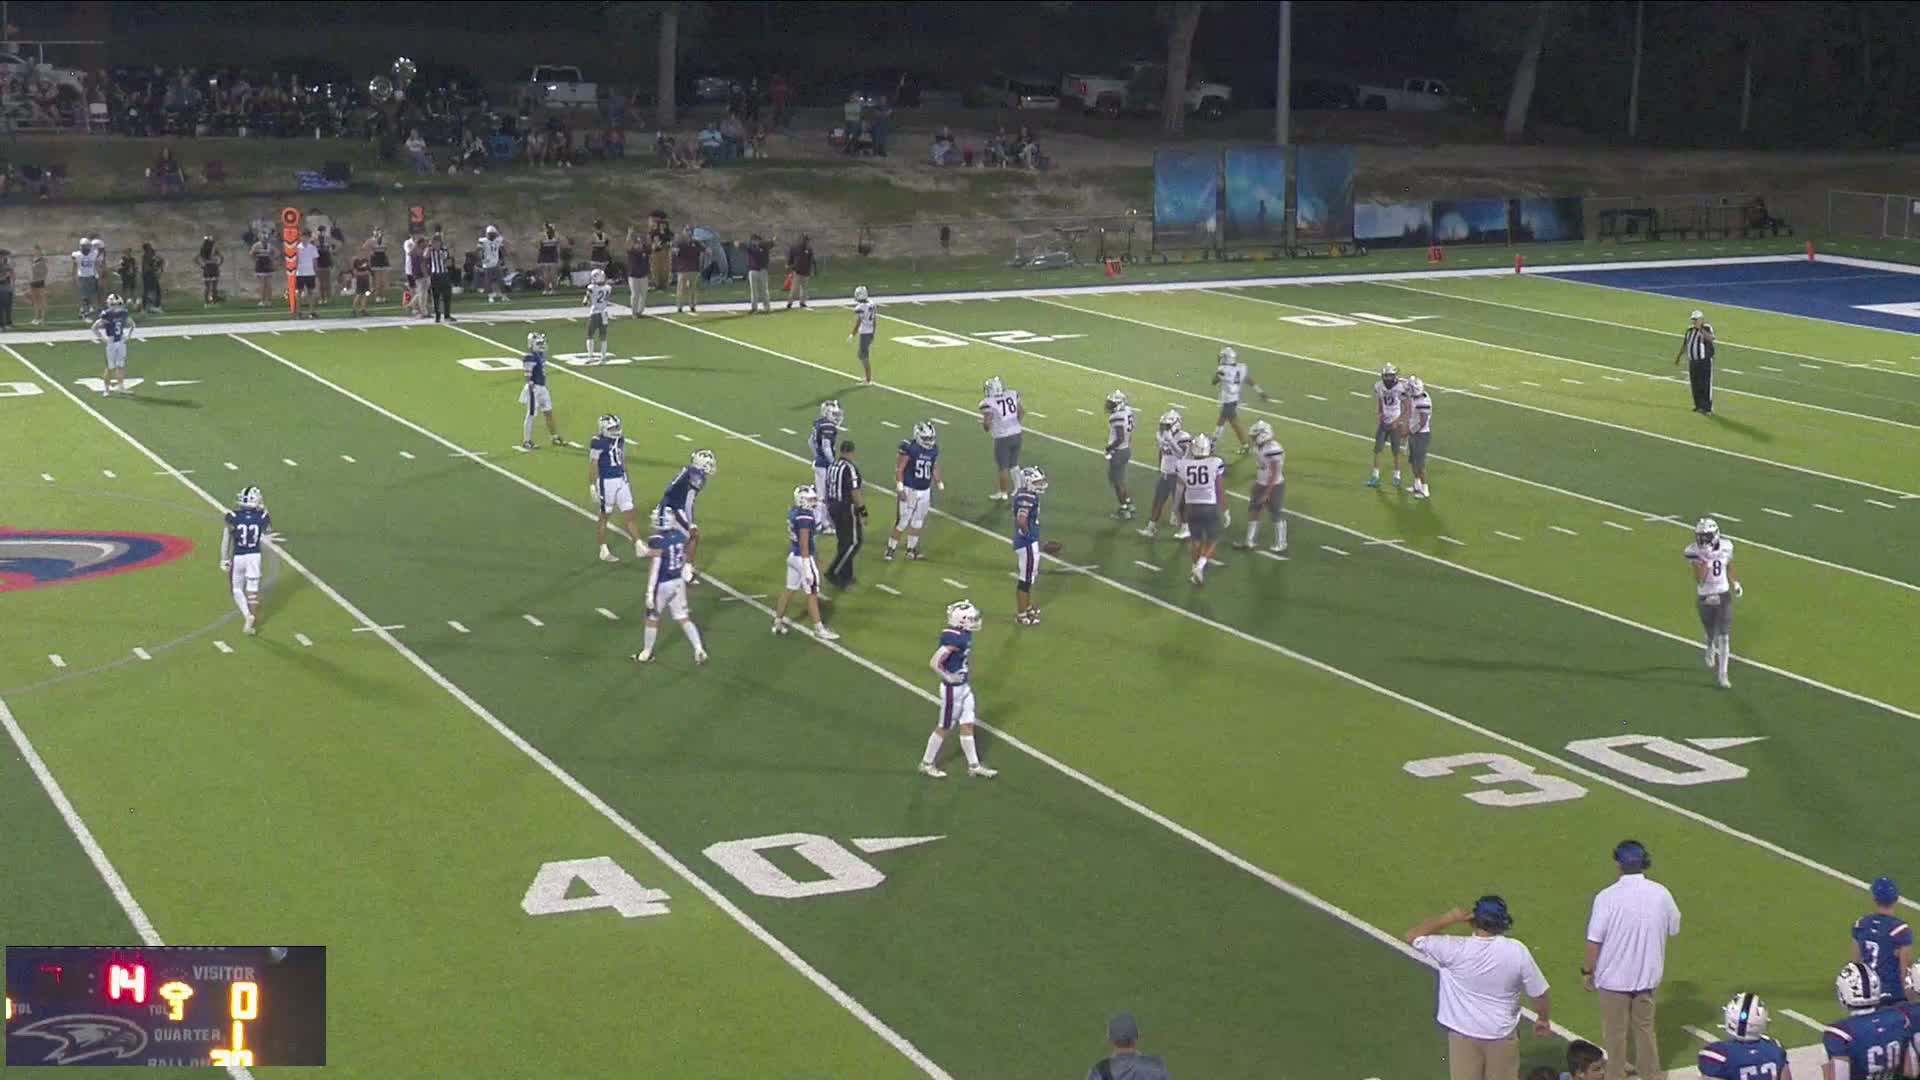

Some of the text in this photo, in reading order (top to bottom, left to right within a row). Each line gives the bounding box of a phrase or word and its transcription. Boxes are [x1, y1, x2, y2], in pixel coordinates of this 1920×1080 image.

[996, 396, 1017, 417] 78
[914, 459, 932, 480] 50
[1186, 465, 1209, 486] 56
[236, 523, 260, 548] 33
[1712, 559, 1722, 577] 8
